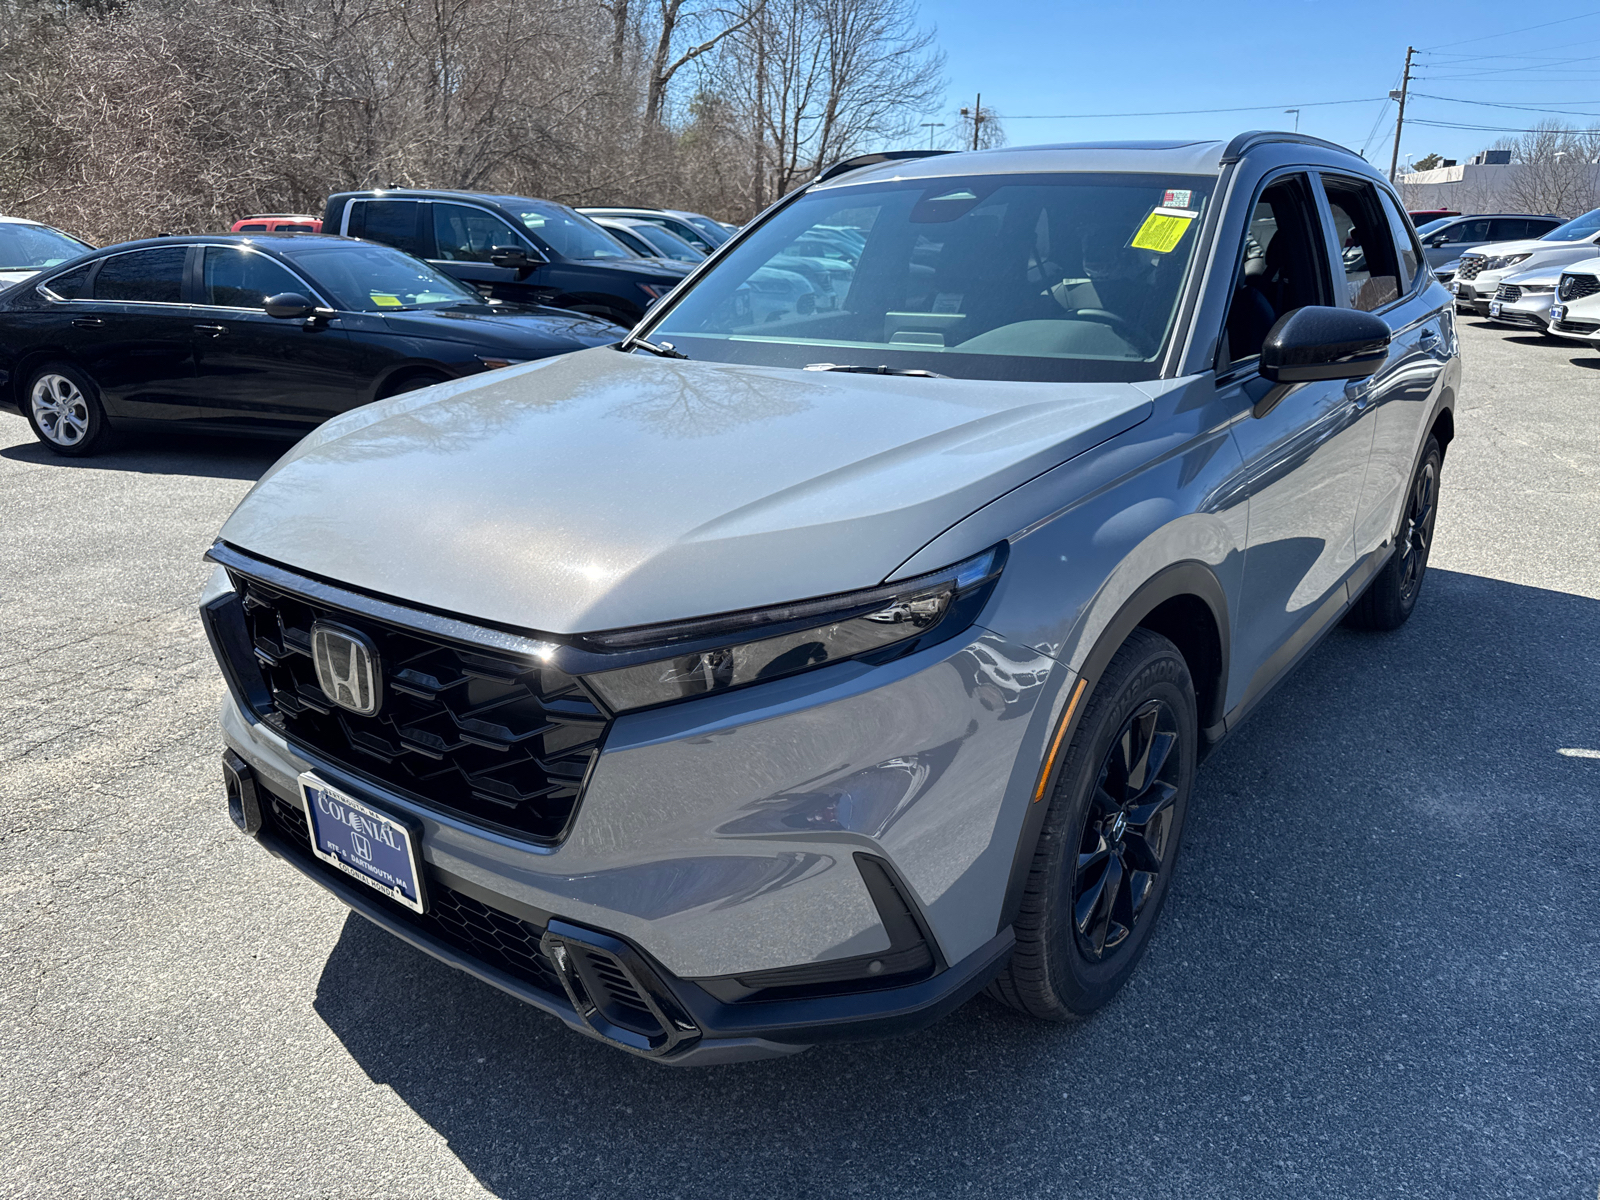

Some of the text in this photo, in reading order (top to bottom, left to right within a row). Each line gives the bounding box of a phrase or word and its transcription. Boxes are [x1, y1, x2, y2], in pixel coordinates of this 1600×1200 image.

[318, 795, 401, 851] COLONIAL
[338, 862, 395, 898] COLONIAL HONDA
[396, 877, 408, 890] MA
